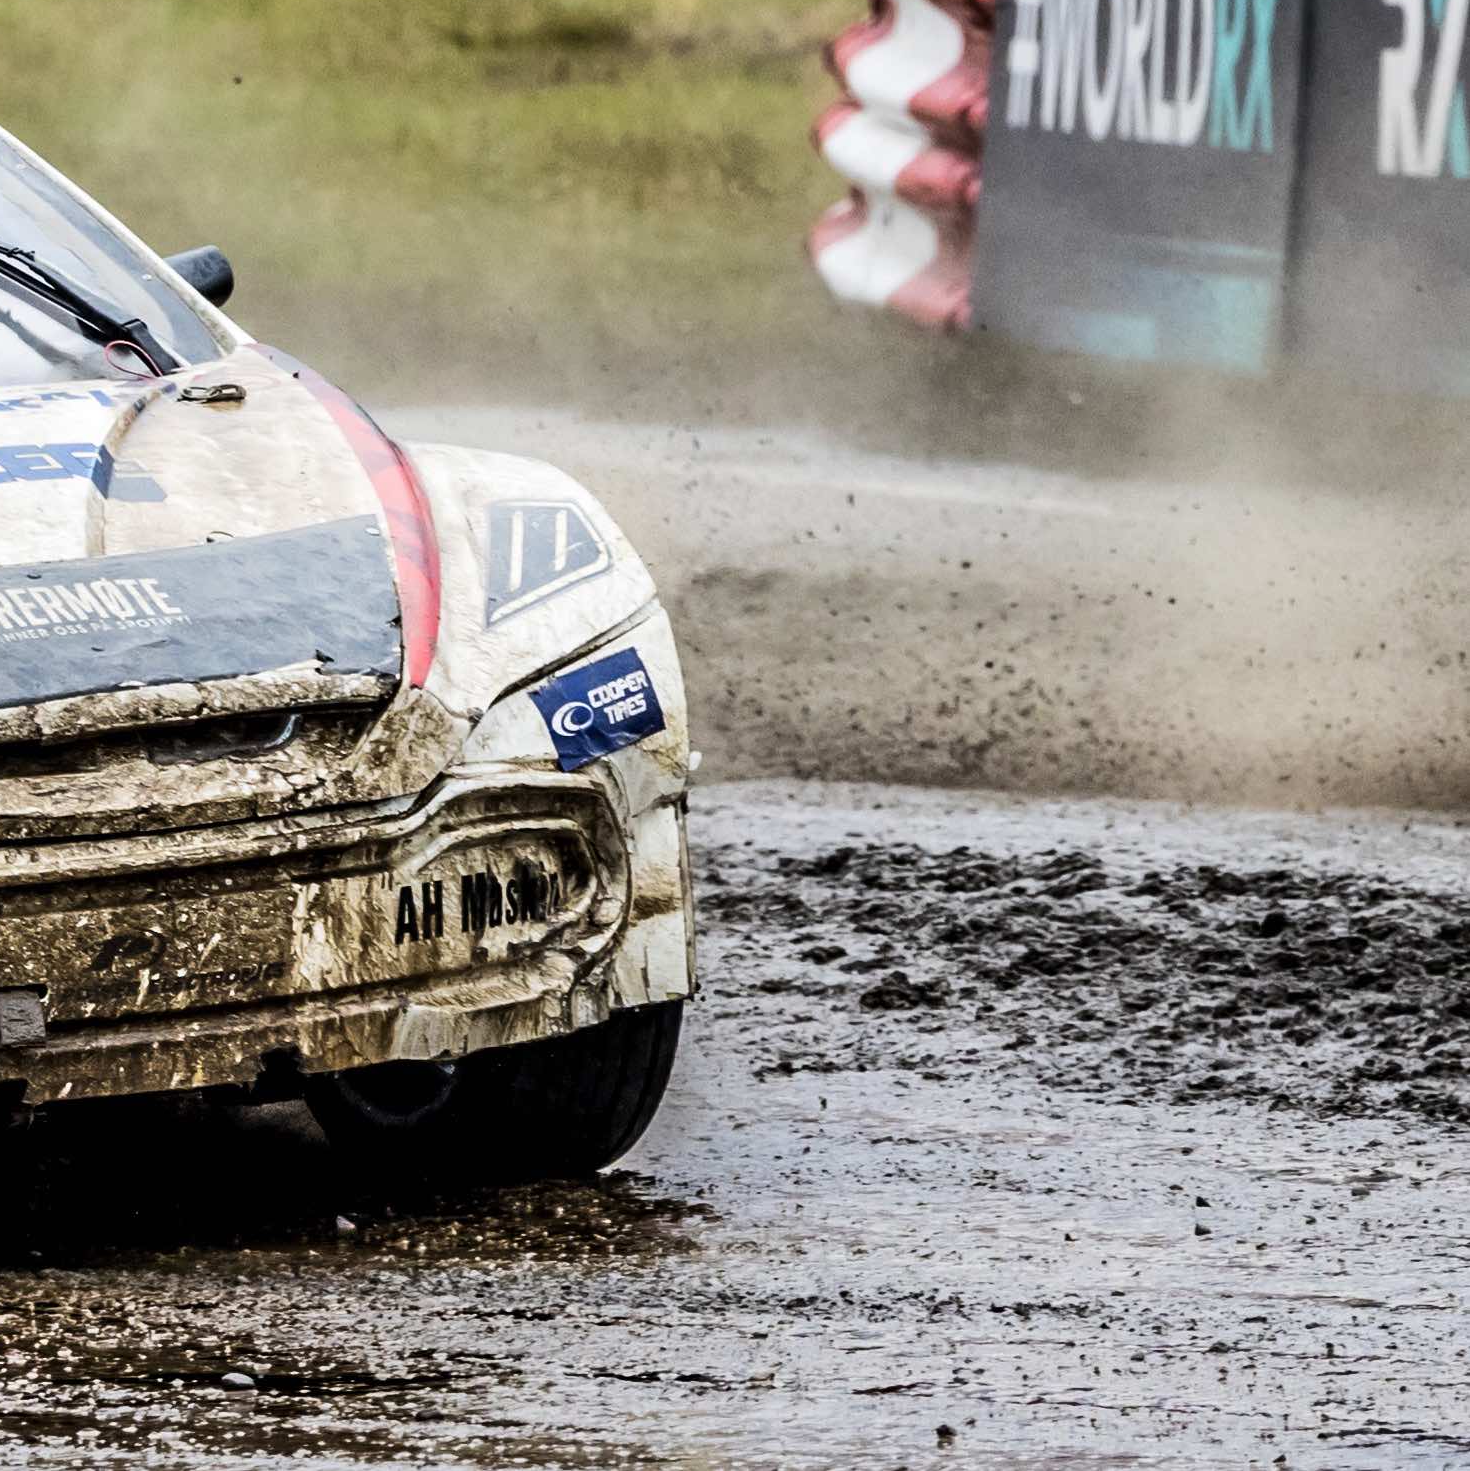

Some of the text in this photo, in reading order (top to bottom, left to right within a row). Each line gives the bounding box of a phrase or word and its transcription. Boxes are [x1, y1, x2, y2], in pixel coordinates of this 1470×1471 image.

[53, 622, 89, 637] OSS
[587, 670, 649, 709] COOPER
[603, 692, 647, 725] TIRES
[394, 880, 444, 946] AH
